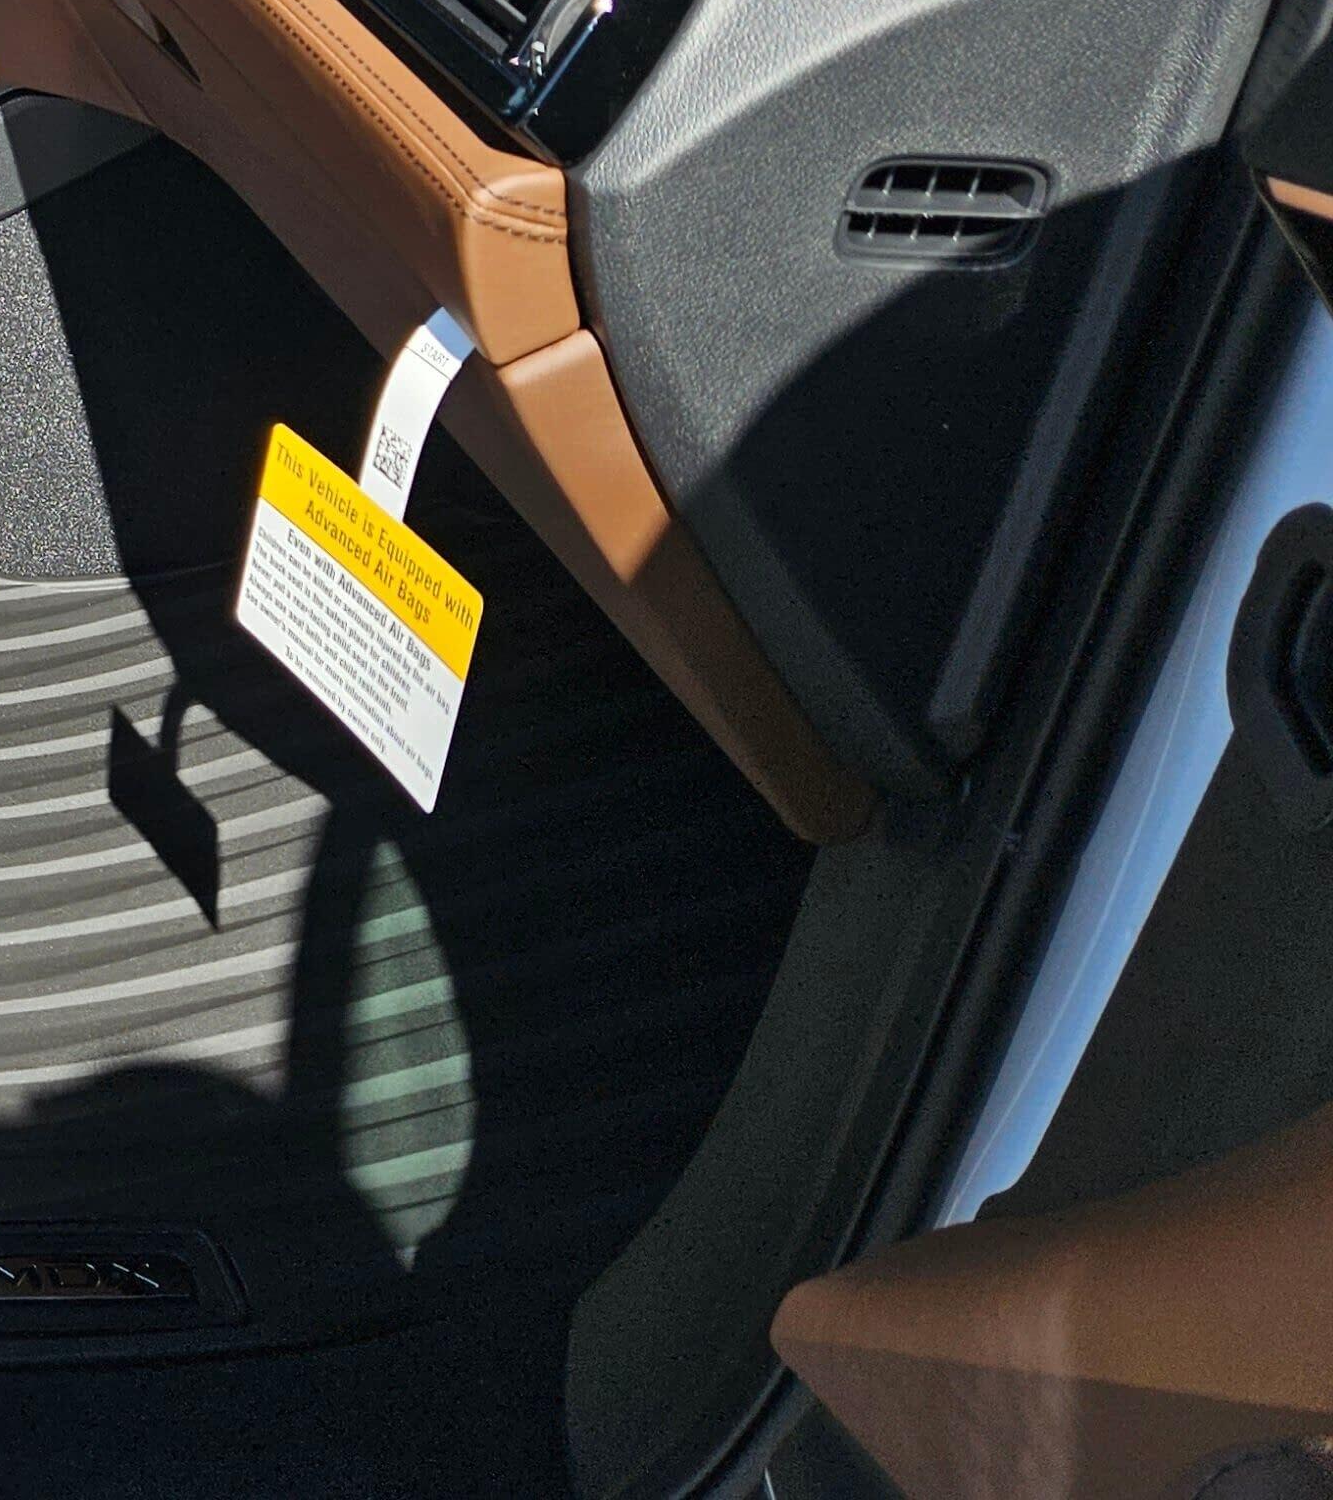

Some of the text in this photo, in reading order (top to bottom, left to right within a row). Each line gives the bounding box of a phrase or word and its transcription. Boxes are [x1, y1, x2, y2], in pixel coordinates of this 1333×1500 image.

[420, 342, 450, 368] START
[275, 442, 475, 631] This Vehicle is Equipped with
[286, 527, 433, 674] Even with Advanced Air Bags
[305, 497, 432, 628] Advanced Air Bags
